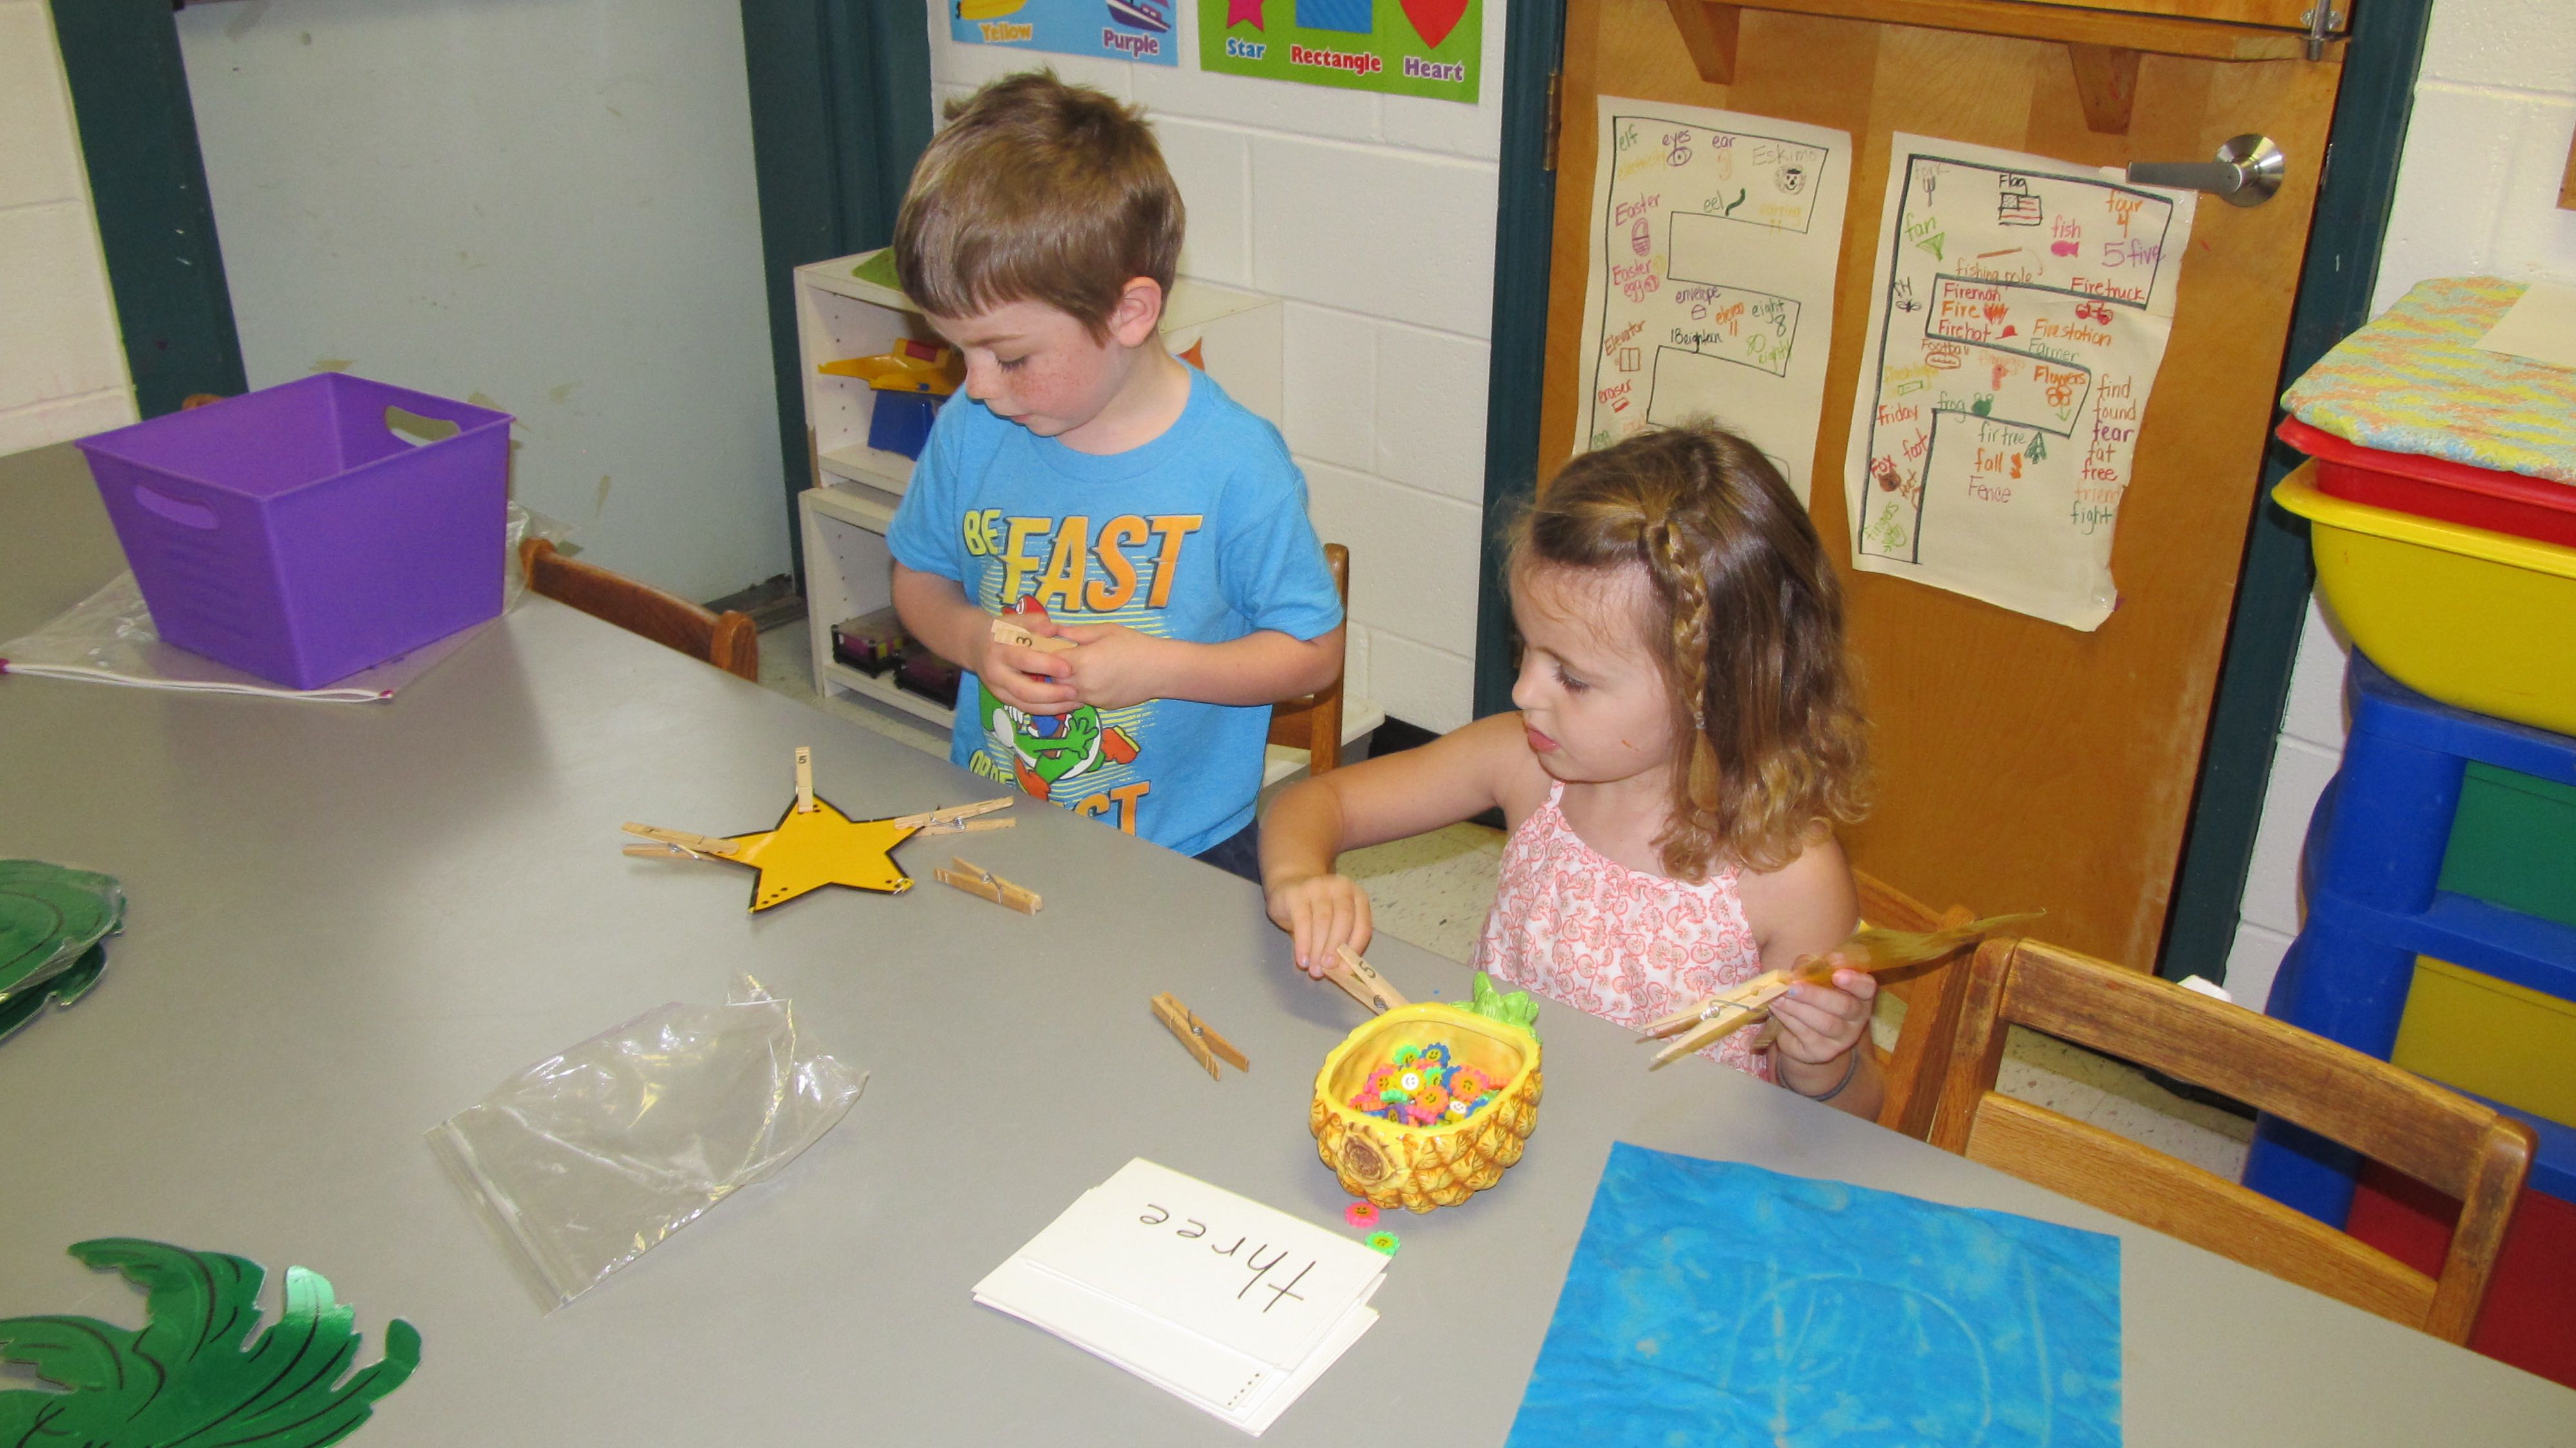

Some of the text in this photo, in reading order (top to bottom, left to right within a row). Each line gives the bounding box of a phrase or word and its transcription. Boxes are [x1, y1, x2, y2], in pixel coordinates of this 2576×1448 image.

[980, 22, 1032, 42] Yellow
[1103, 27, 1159, 59] Purple
[1226, 37, 1267, 59] Star
[1291, 44, 1382, 76] Rectangle
[1404, 57, 1464, 82] Heart
[1619, 124, 1638, 151] elf
[1662, 129, 1690, 149] eyes
[1712, 135, 1736, 149] ear
[1998, 172, 2028, 196] Flag
[1615, 193, 1660, 227] Easter
[1703, 190, 1723, 213] eel
[2106, 188, 2143, 213] four
[1904, 212, 1937, 242] fan
[2051, 214, 2081, 238] fish
[2101, 242, 2125, 267] 5
[1612, 259, 1651, 286] Easter
[1955, 258, 2000, 289] fishing
[1624, 280, 1645, 303] egg
[1944, 282, 2001, 301] Fireman
[1752, 298, 1785, 324] eight
[1941, 300, 1980, 318] Fire
[2029, 338, 2079, 361] Farmer
[1598, 379, 1632, 404] eraser
[2097, 373, 2132, 399] find
[1937, 390, 1965, 423] frog
[2092, 395, 2136, 421] found
[2002, 426, 2027, 446] tree
[2092, 419, 2134, 443] fear
[1974, 448, 2003, 473] fall
[2087, 440, 2117, 464] fat
[2081, 457, 2118, 481] free
[1968, 475, 2011, 503] Fence
[2070, 500, 2112, 535] fight
[963, 508, 1204, 613] BE FAST
[1359, 960, 1376, 979] 5
[1139, 1203, 1316, 1313] three
